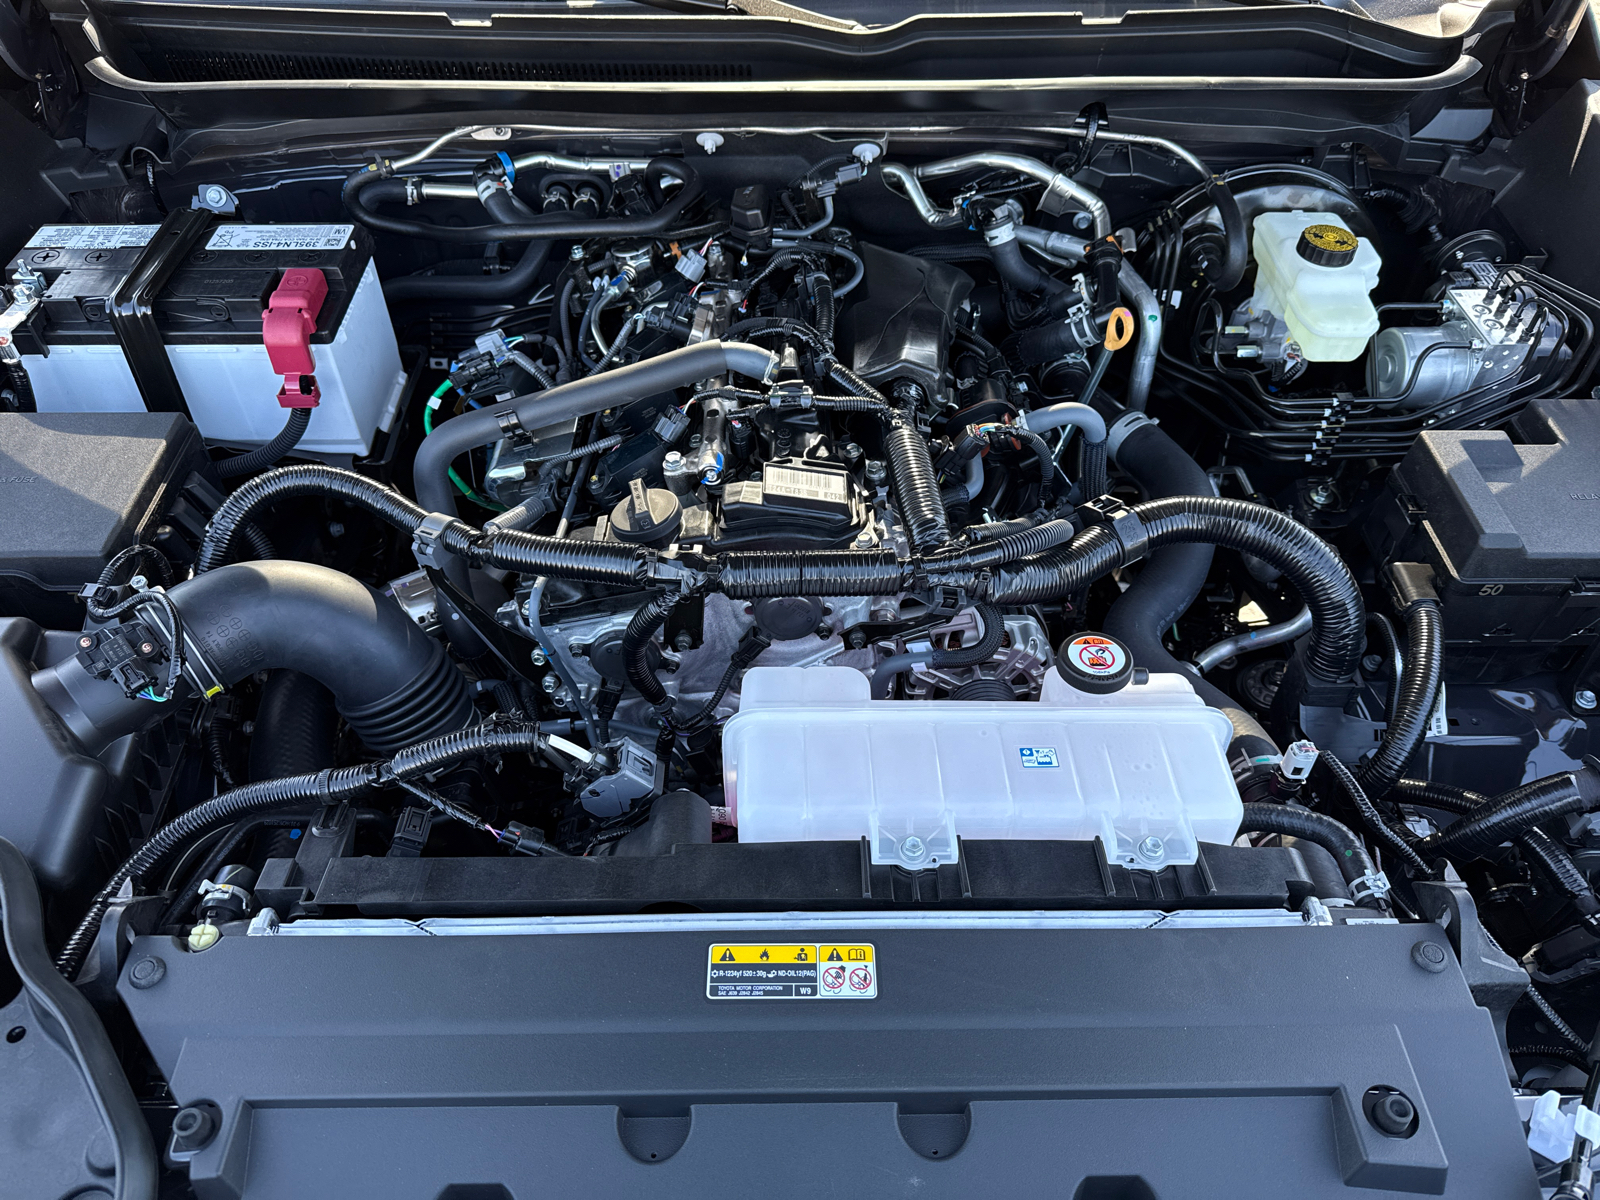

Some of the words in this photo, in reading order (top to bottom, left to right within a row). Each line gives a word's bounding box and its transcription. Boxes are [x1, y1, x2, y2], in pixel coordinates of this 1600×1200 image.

[1478, 584, 1504, 596] 50
[719, 970, 742, 978] R-1234yf
[778, 970, 816, 978] ND-OIL12(PAG)
[800, 987, 811, 995] W9
